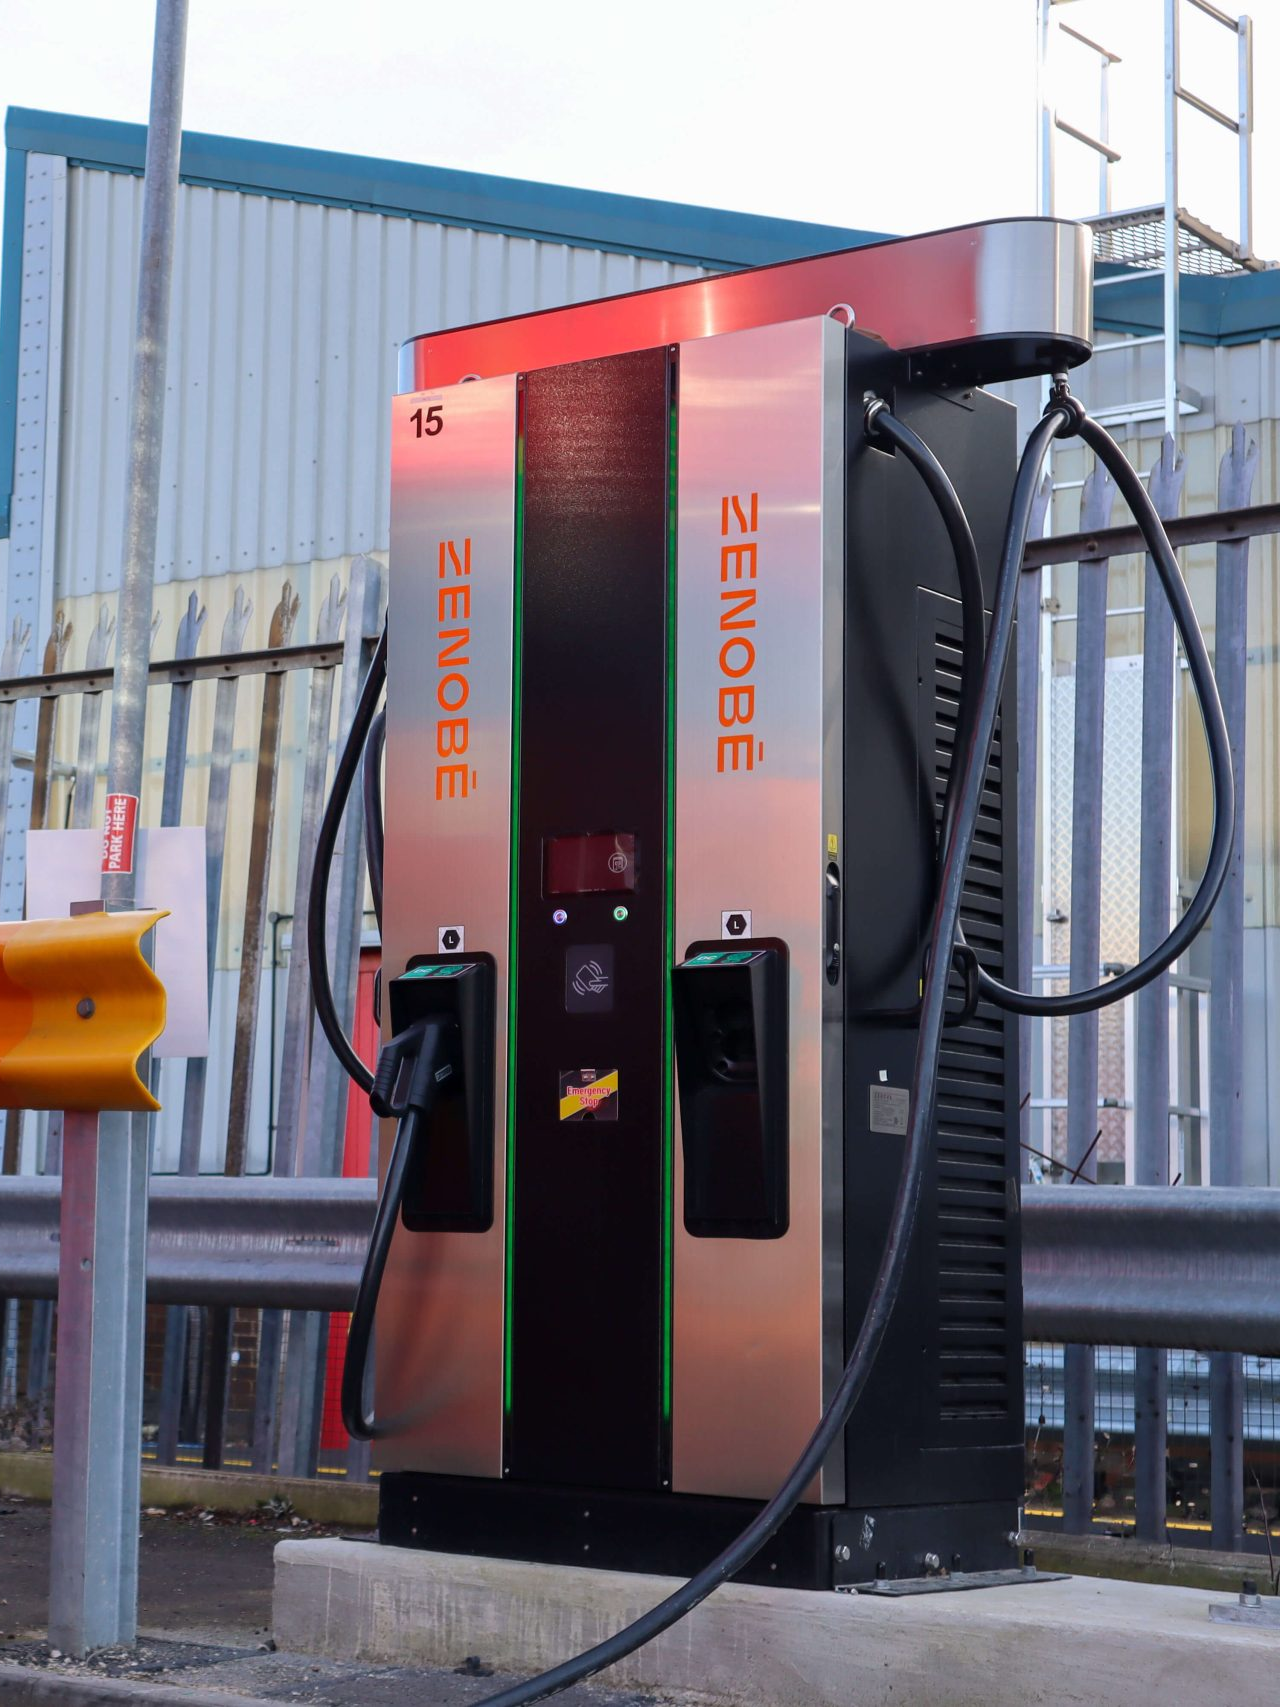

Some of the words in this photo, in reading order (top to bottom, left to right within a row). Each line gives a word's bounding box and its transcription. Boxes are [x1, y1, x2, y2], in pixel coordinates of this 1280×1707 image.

[410, 405, 443, 438] 15
[112, 797, 127, 831] HERE
[108, 835, 124, 869] PARK
[566, 1085, 611, 1098] Emergency
[579, 1096, 599, 1108] Stop
